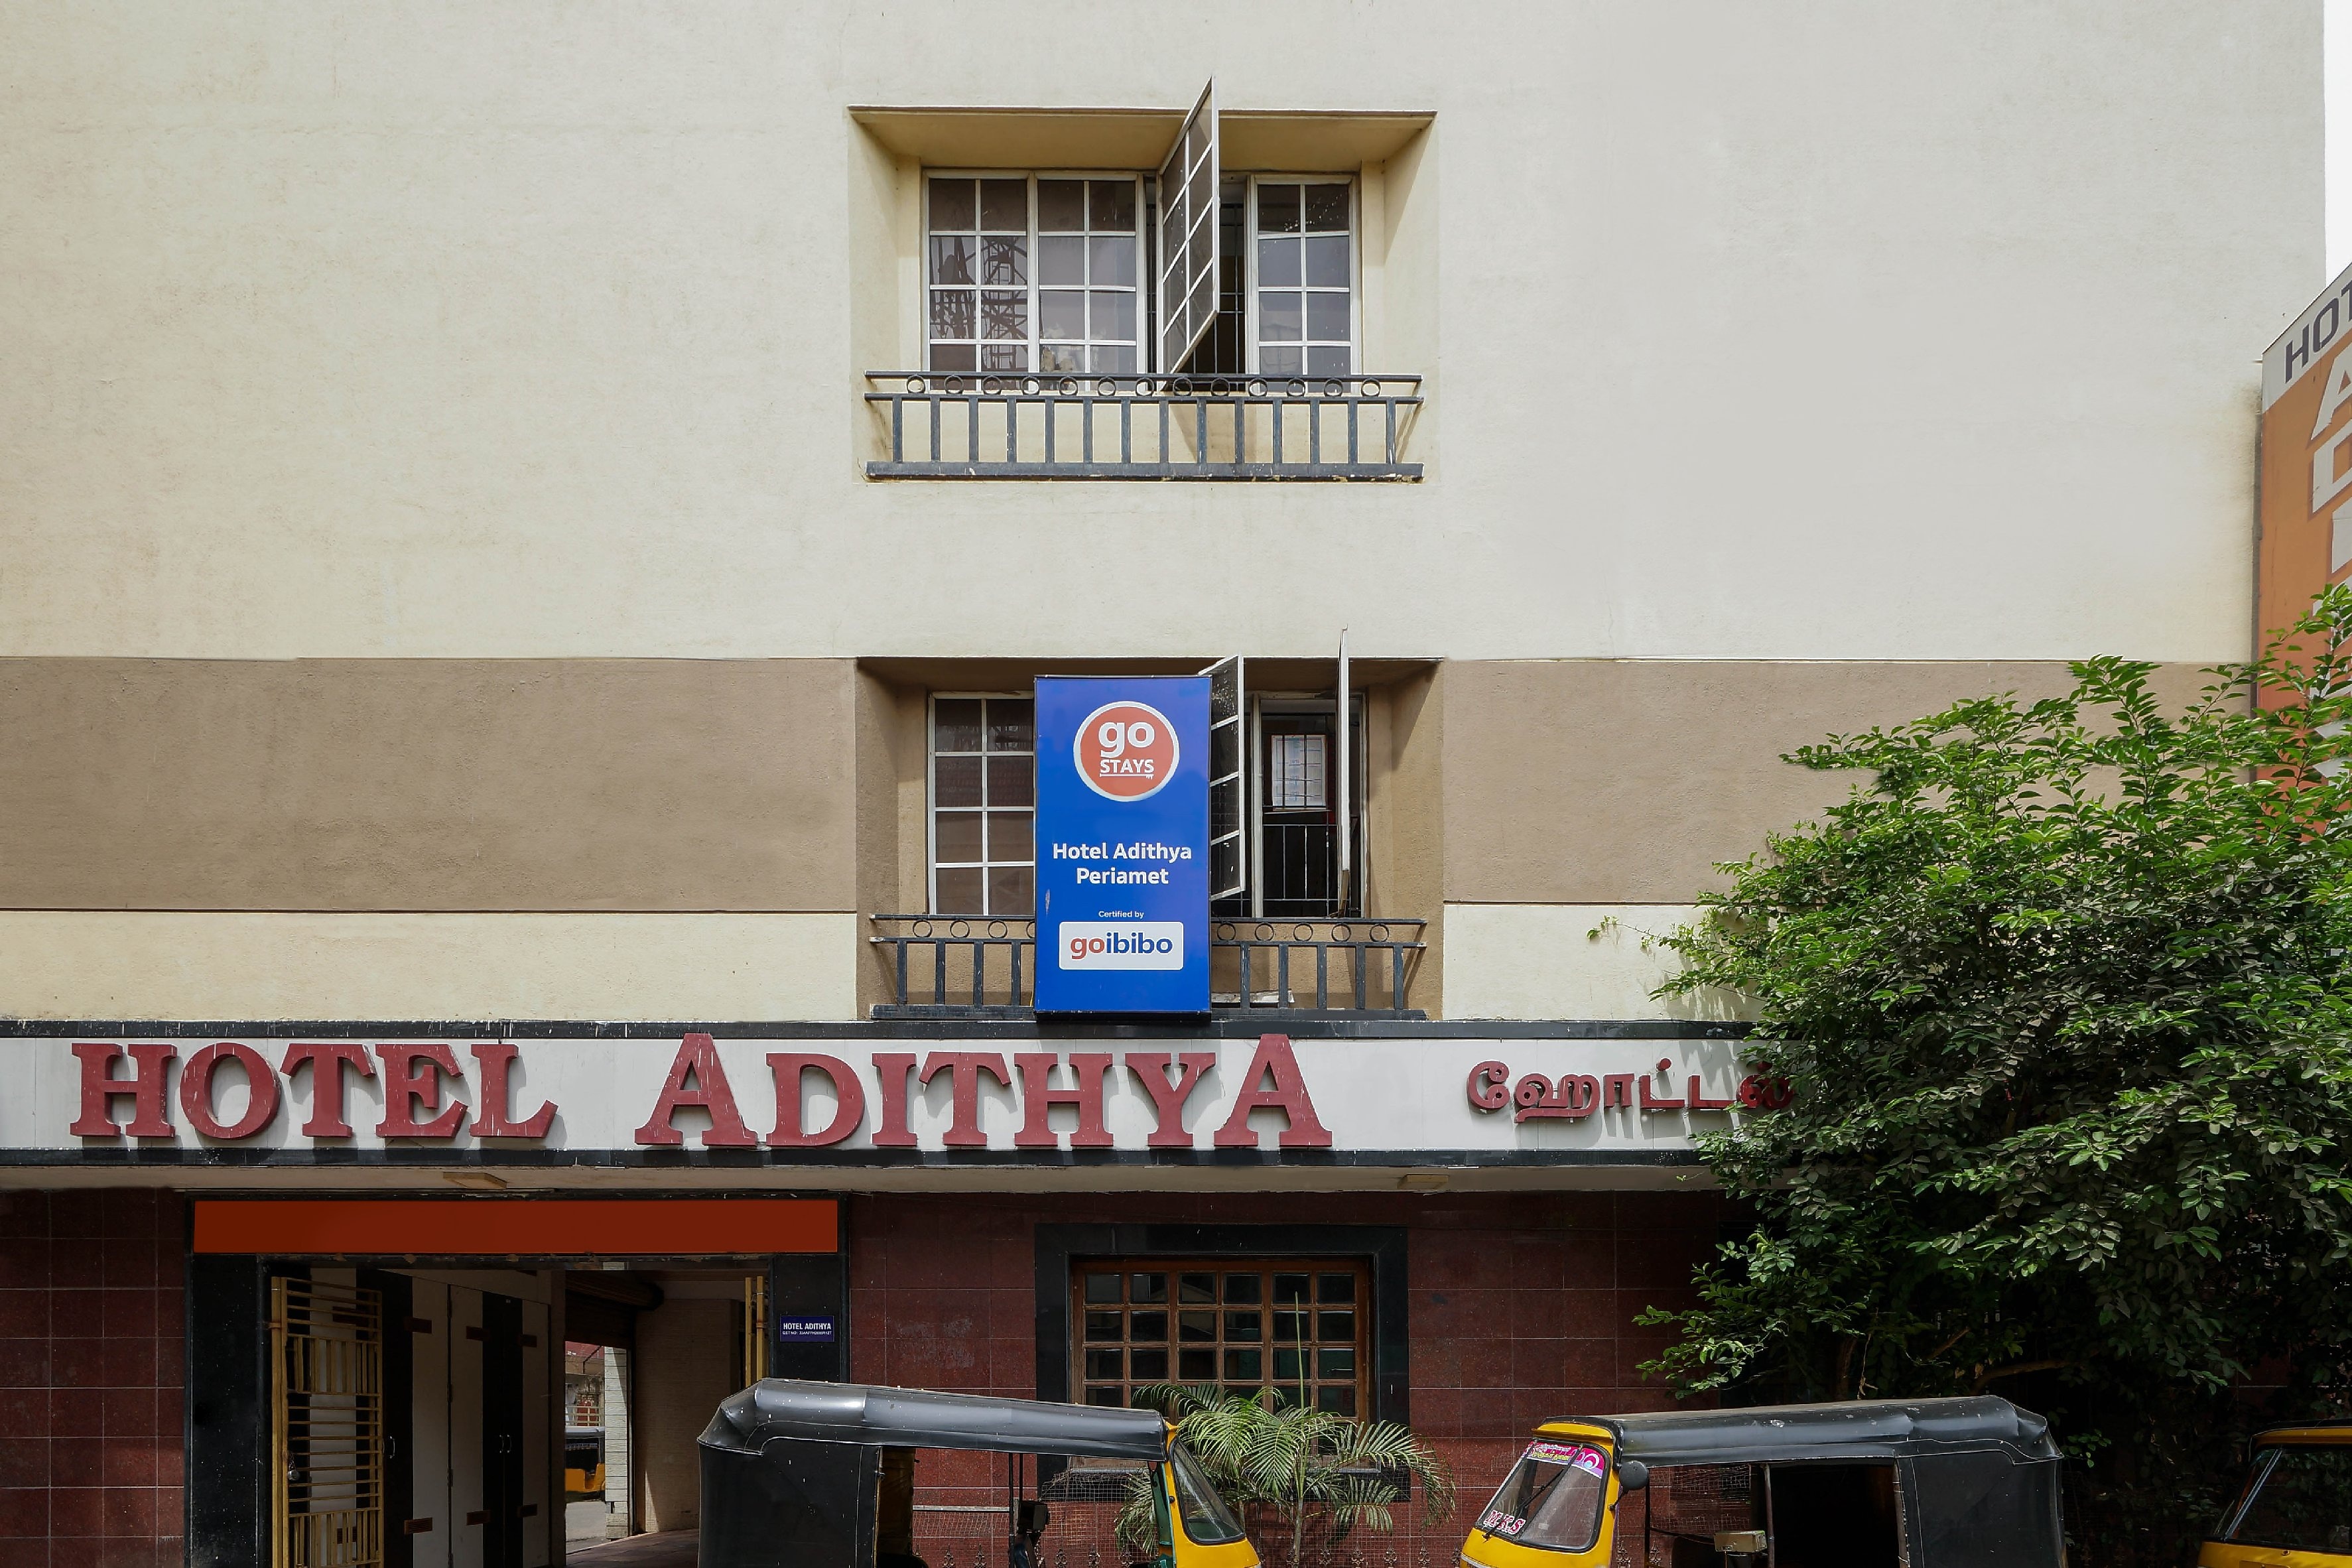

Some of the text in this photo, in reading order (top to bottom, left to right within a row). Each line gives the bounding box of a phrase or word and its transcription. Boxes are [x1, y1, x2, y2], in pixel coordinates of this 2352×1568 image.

[1098, 720, 1155, 759] go
[1100, 759, 1155, 774] STAYS
[1053, 842, 1193, 864] Hotel Adithya
[1076, 867, 1169, 885] Periamet
[1098, 910, 1145, 920] Certified by
[1070, 932, 1174, 960] goibibo
[70, 1033, 1334, 1147] HOTEL ADITHYA
